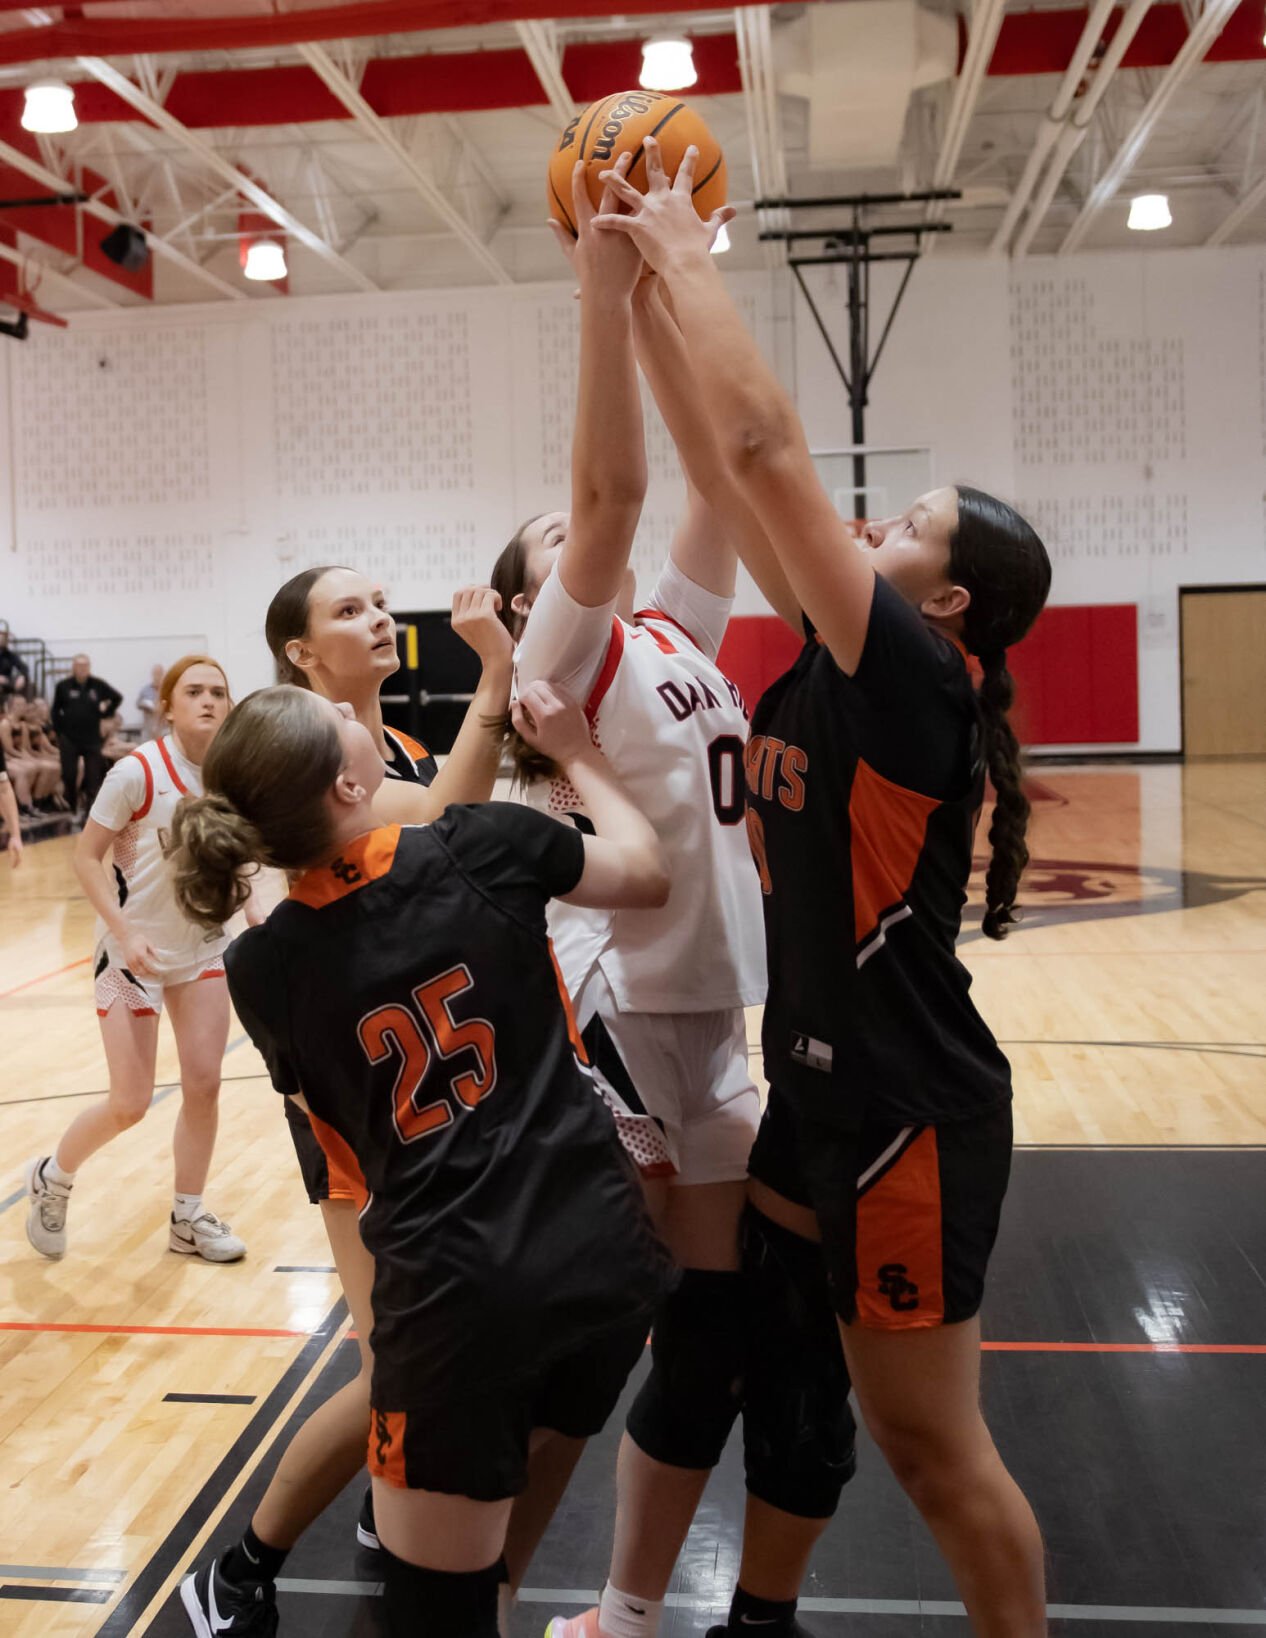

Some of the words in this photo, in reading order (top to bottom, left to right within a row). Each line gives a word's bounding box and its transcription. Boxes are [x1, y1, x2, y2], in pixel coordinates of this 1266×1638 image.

[707, 734, 746, 826] 0
[356, 963, 497, 1144] 25
[877, 1263, 919, 1312] SC
